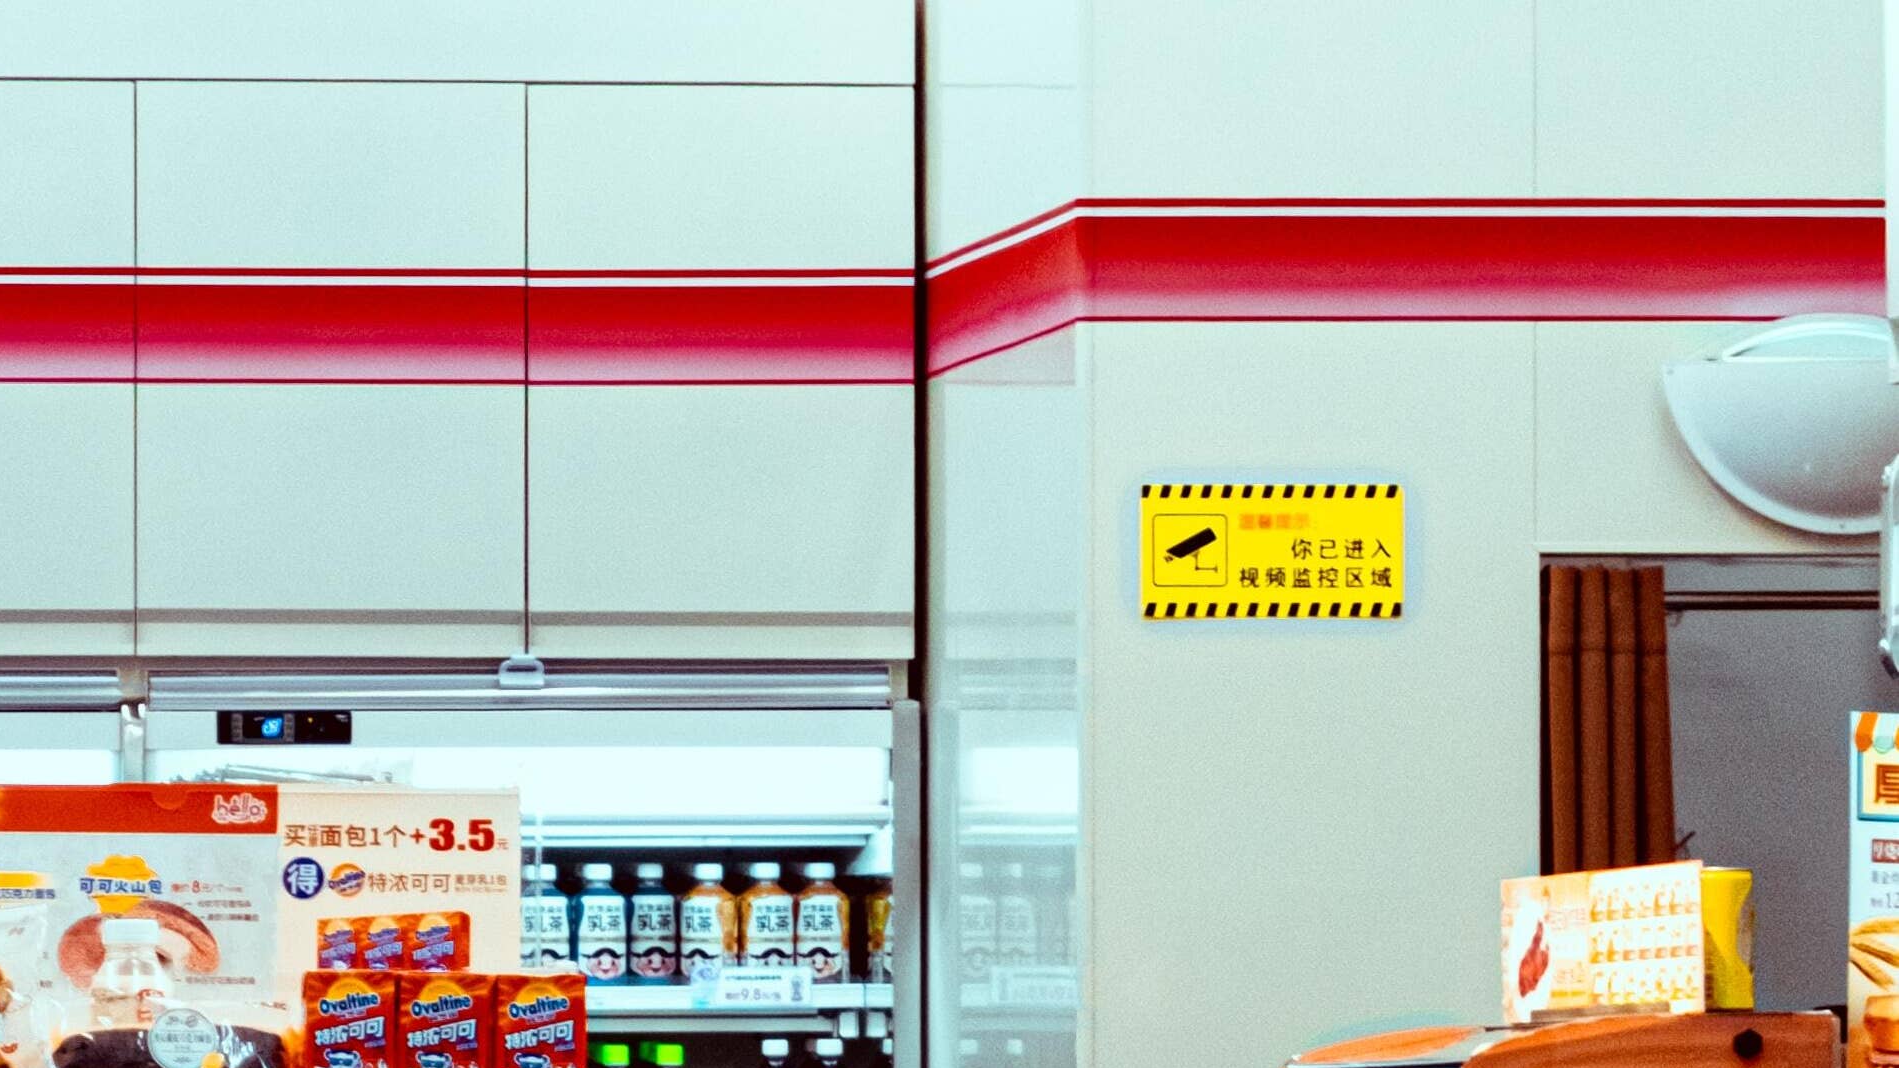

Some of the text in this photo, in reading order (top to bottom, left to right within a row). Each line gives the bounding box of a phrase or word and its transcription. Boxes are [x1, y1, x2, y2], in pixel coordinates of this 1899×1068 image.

[1291, 538, 1392, 559] 你已进入
[1239, 567, 1393, 588] 视频监控区域
[79, 877, 163, 894] 可可火山包
[288, 862, 320, 895] 得
[368, 873, 451, 893] 特浓可可
[587, 914, 621, 932] 乳茶
[637, 914, 673, 932] 乳茶
[756, 914, 792, 932] 乳茶
[802, 914, 836, 932] 乳茶
[319, 992, 380, 1015] Ovaltine
[411, 994, 473, 1017] Ovaltine
[508, 996, 569, 1019] Ovaltine
[314, 1017, 385, 1046] 特浓可可
[407, 1019, 477, 1047] 特浓可可
[504, 1021, 574, 1050] 特浓可可
